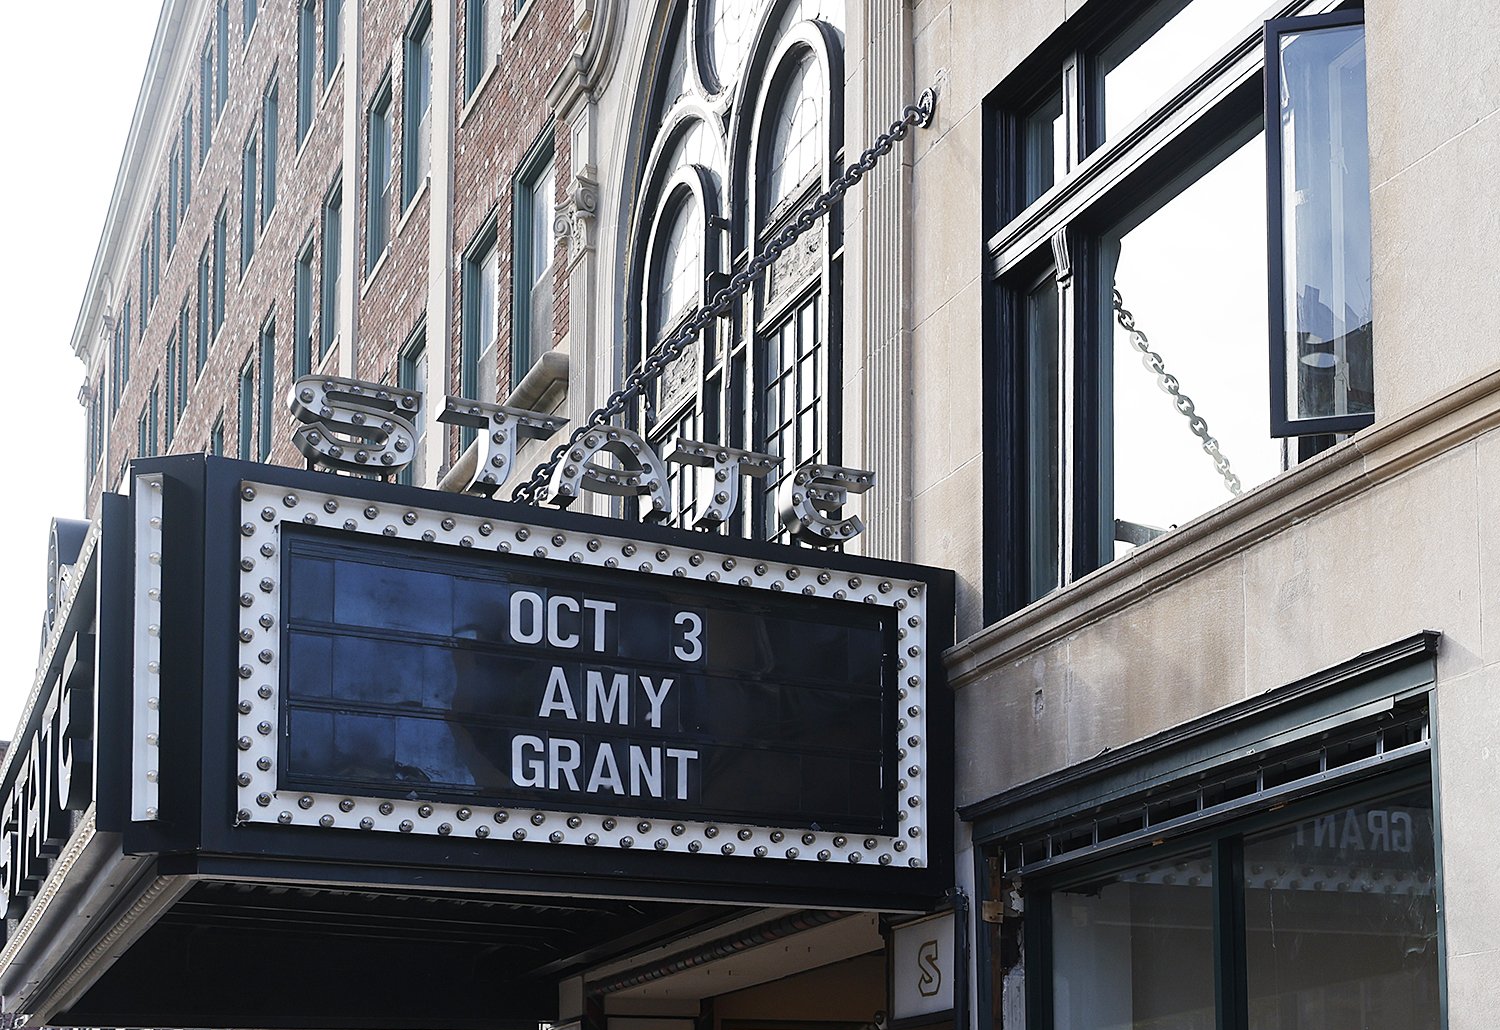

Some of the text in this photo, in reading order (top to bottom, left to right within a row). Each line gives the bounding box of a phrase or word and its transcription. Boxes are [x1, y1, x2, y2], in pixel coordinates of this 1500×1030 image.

[287, 373, 876, 546] STATE
[511, 591, 701, 661] OCT 3
[539, 667, 673, 727] AMY
[512, 735, 697, 799] GRANT
